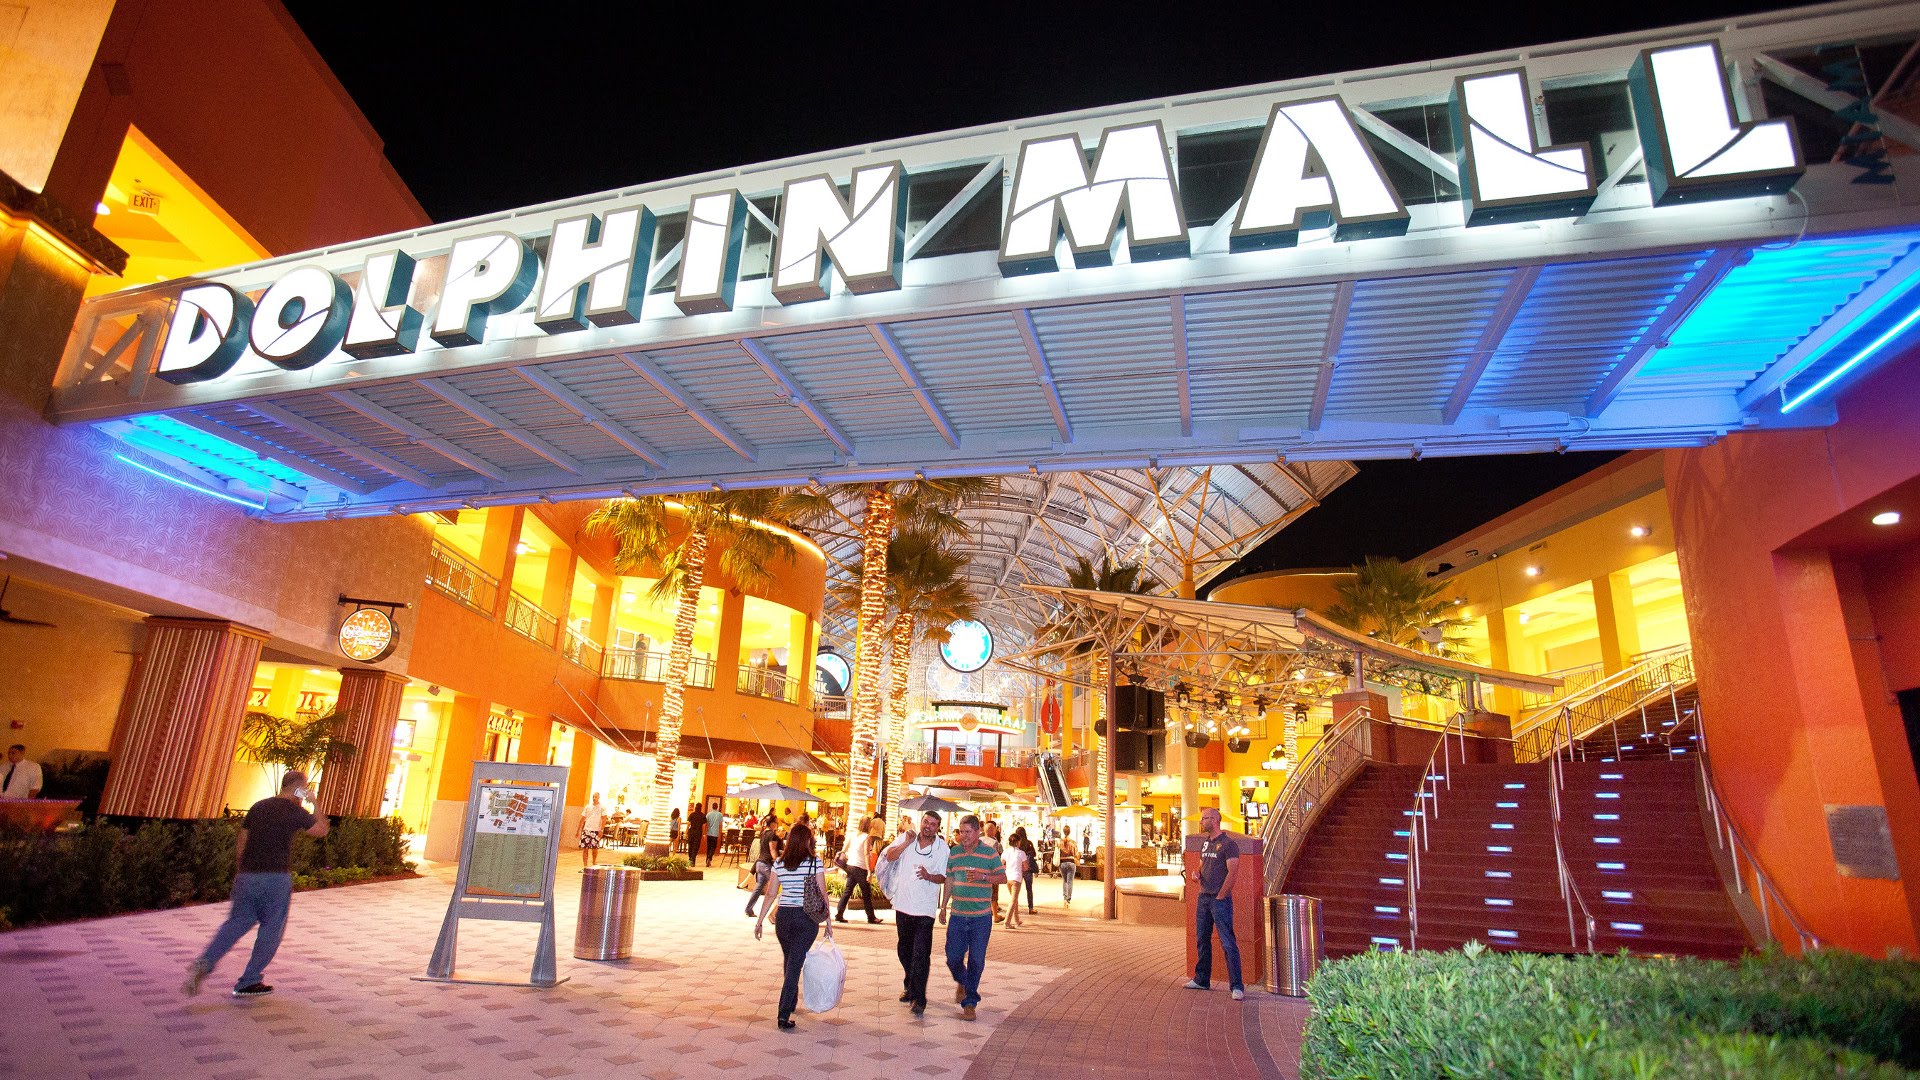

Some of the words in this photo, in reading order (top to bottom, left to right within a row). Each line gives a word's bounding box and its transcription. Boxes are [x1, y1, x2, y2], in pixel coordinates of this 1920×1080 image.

[133, 194, 154, 209] EXIT
[155, 161, 906, 384] DOLPHIN
[1000, 38, 1806, 278] MALL
